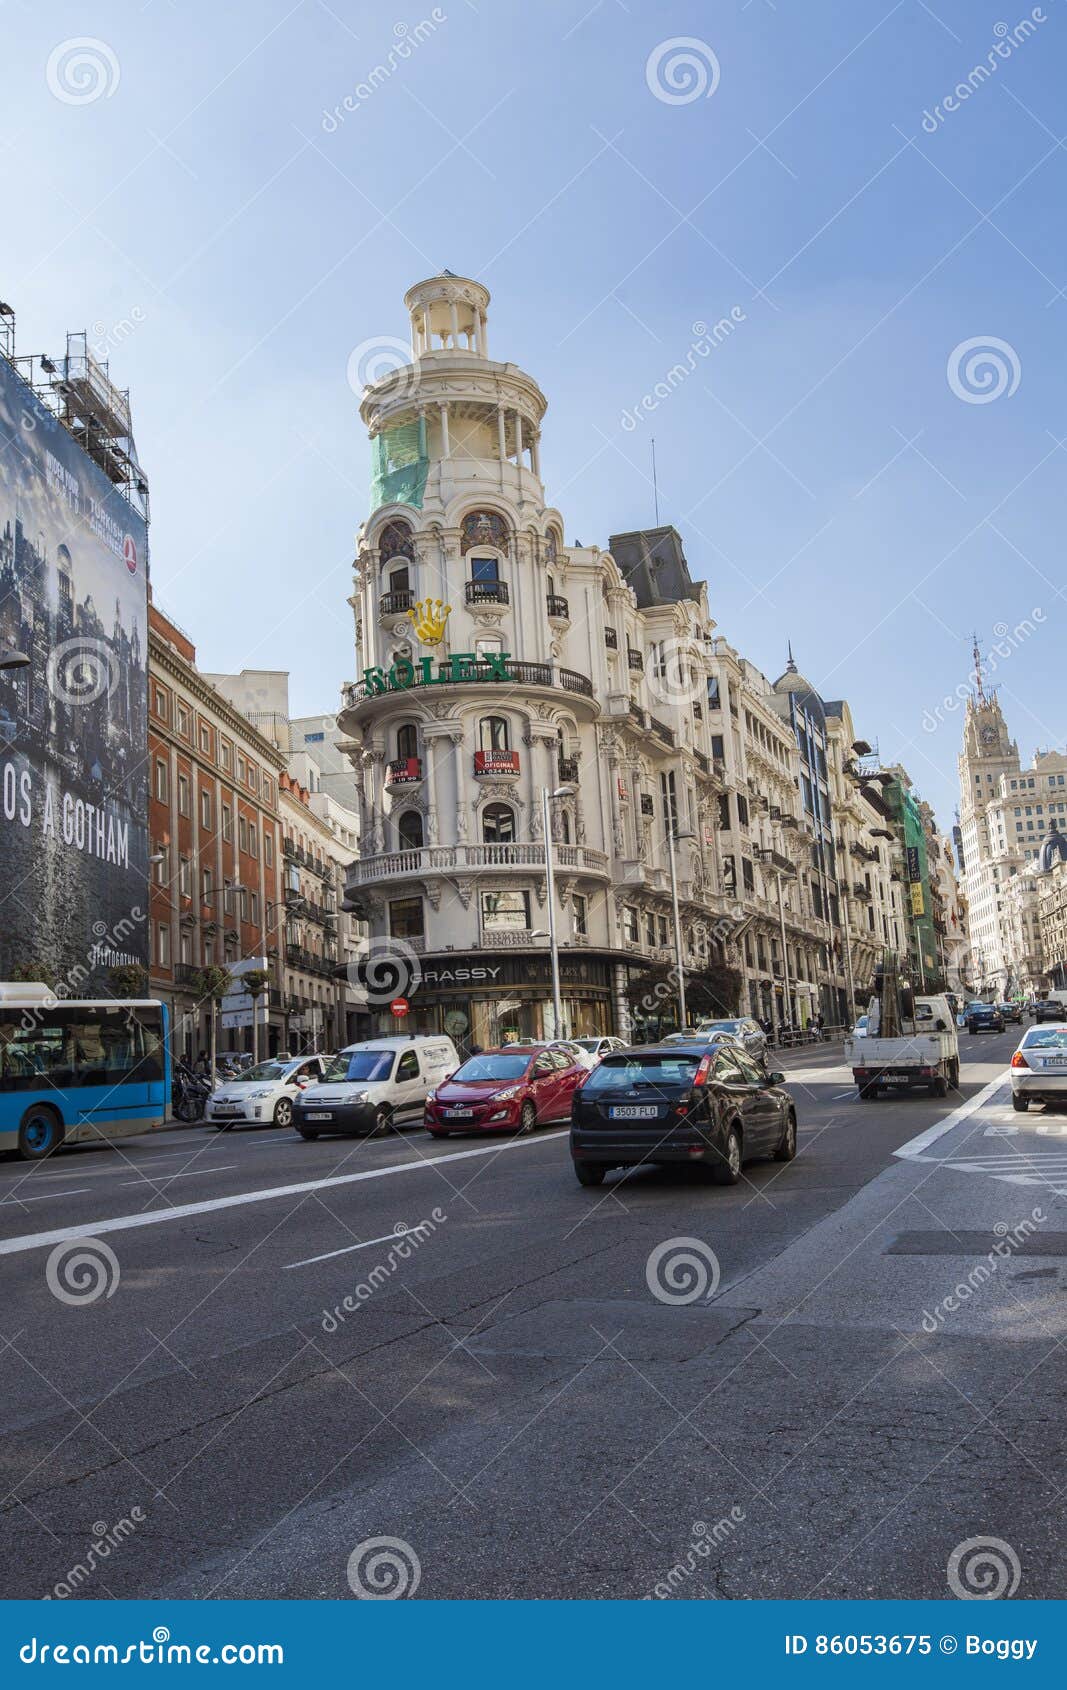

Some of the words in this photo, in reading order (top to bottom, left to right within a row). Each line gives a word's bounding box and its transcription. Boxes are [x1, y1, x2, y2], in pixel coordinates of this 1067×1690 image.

[89, 496, 123, 542] TURKISH
[363, 652, 513, 696] ROLEX
[4, 762, 31, 827] OS
[43, 783, 55, 840] A
[63, 792, 129, 870] GOTHAM
[410, 967, 501, 984] GRASSY
[615, 1107, 637, 1116] 3503
